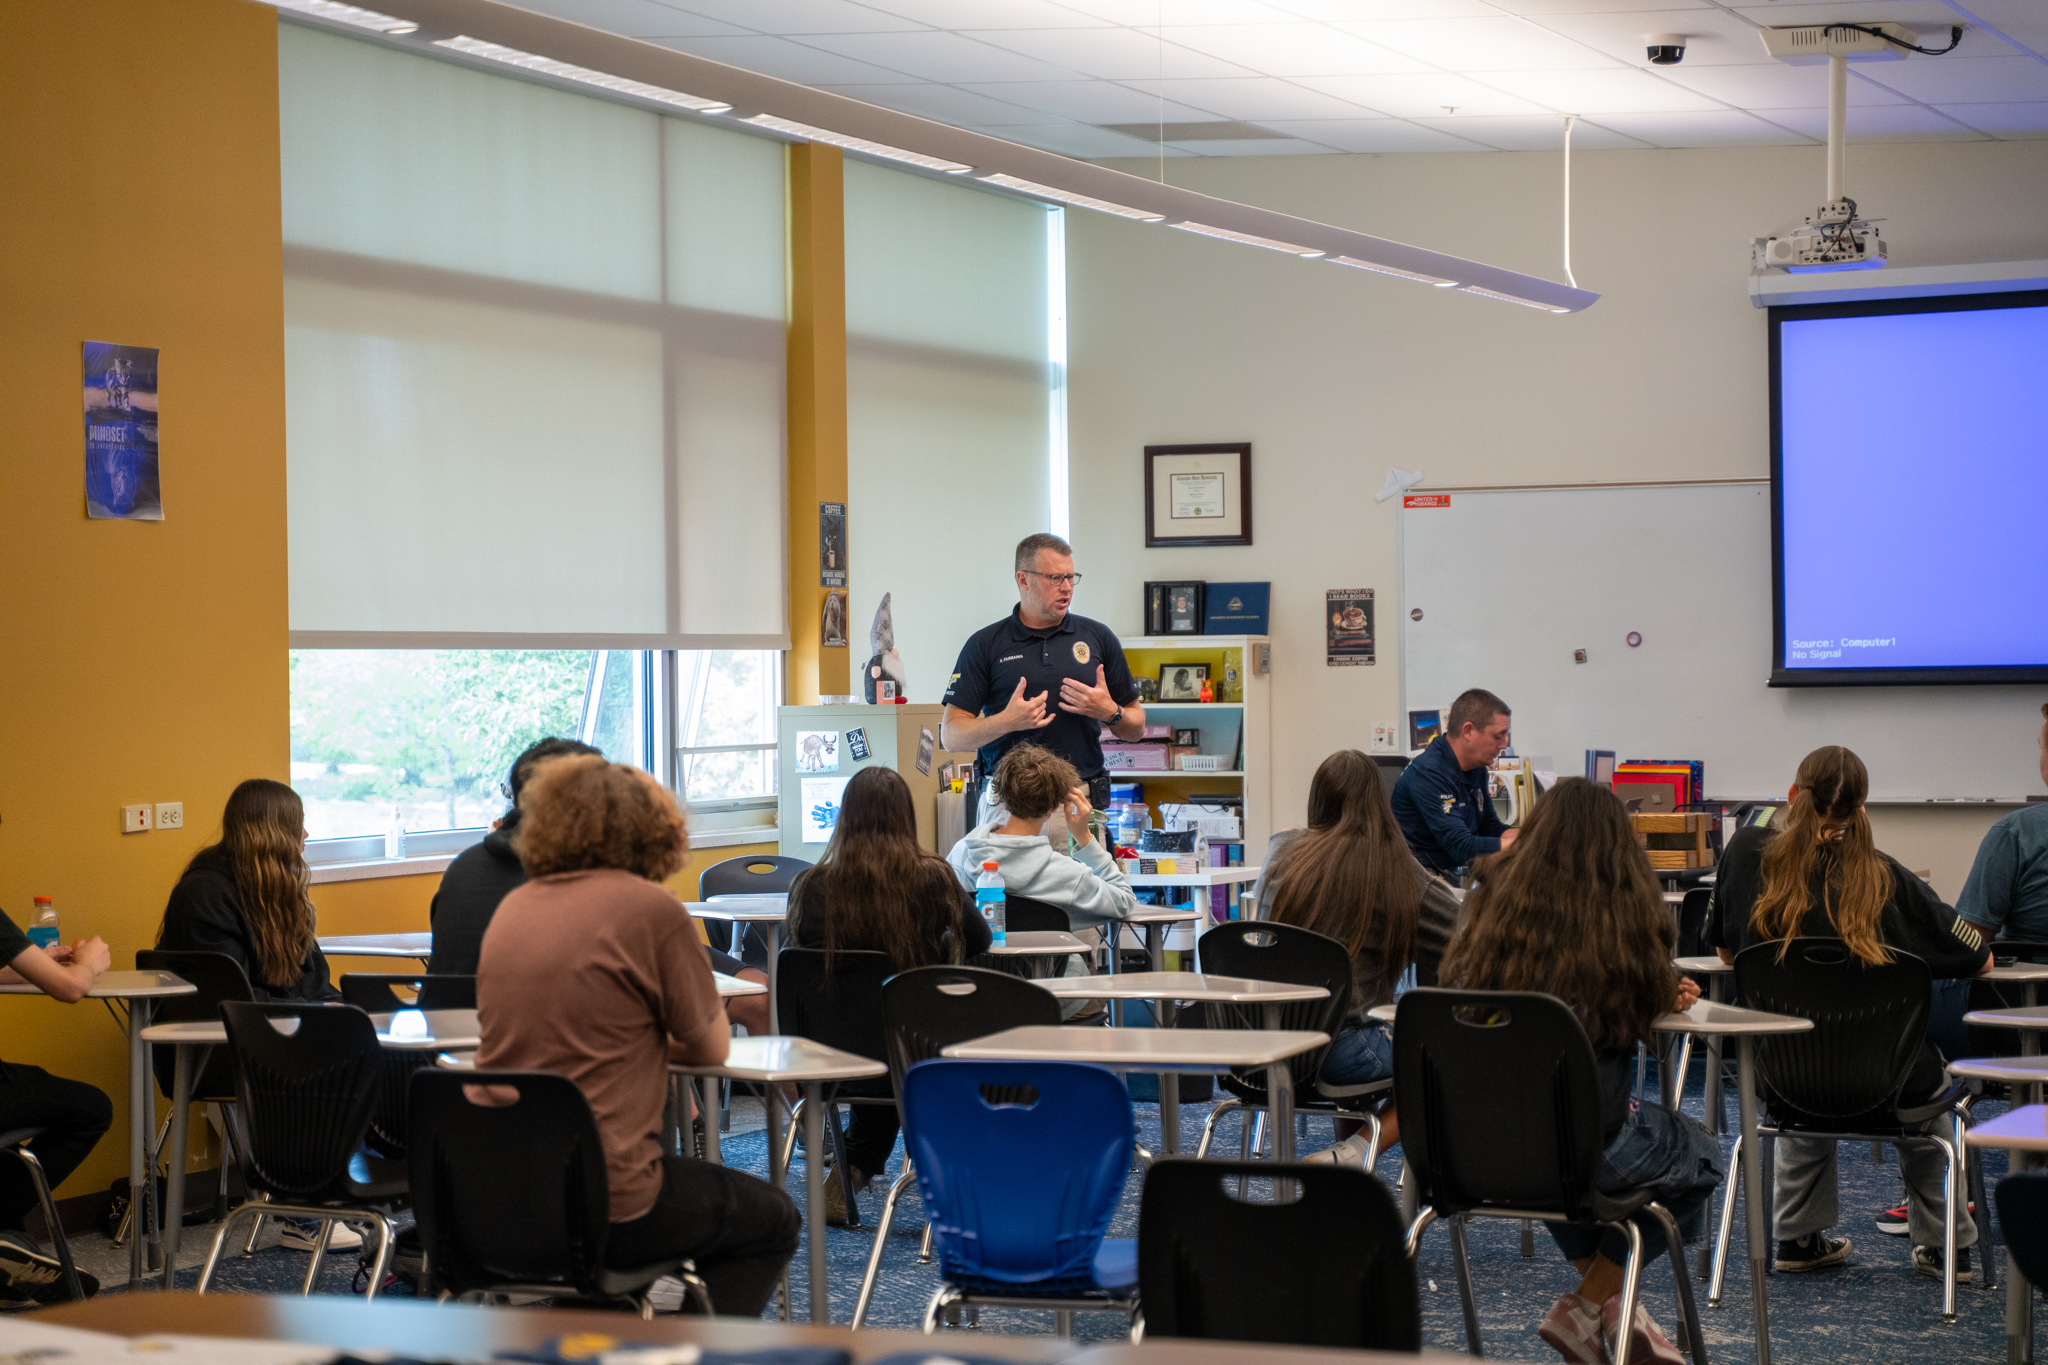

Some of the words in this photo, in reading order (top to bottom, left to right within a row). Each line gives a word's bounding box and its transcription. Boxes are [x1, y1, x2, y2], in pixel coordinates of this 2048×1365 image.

[89, 425, 125, 443] MINDSET
[825, 504, 842, 515] COFFEE
[1792, 639, 1834, 649] Source:
[1841, 637, 1896, 648] Computer1
[1792, 650, 1807, 659] No
[1810, 649, 1842, 660] Signal
[981, 903, 994, 919] G
